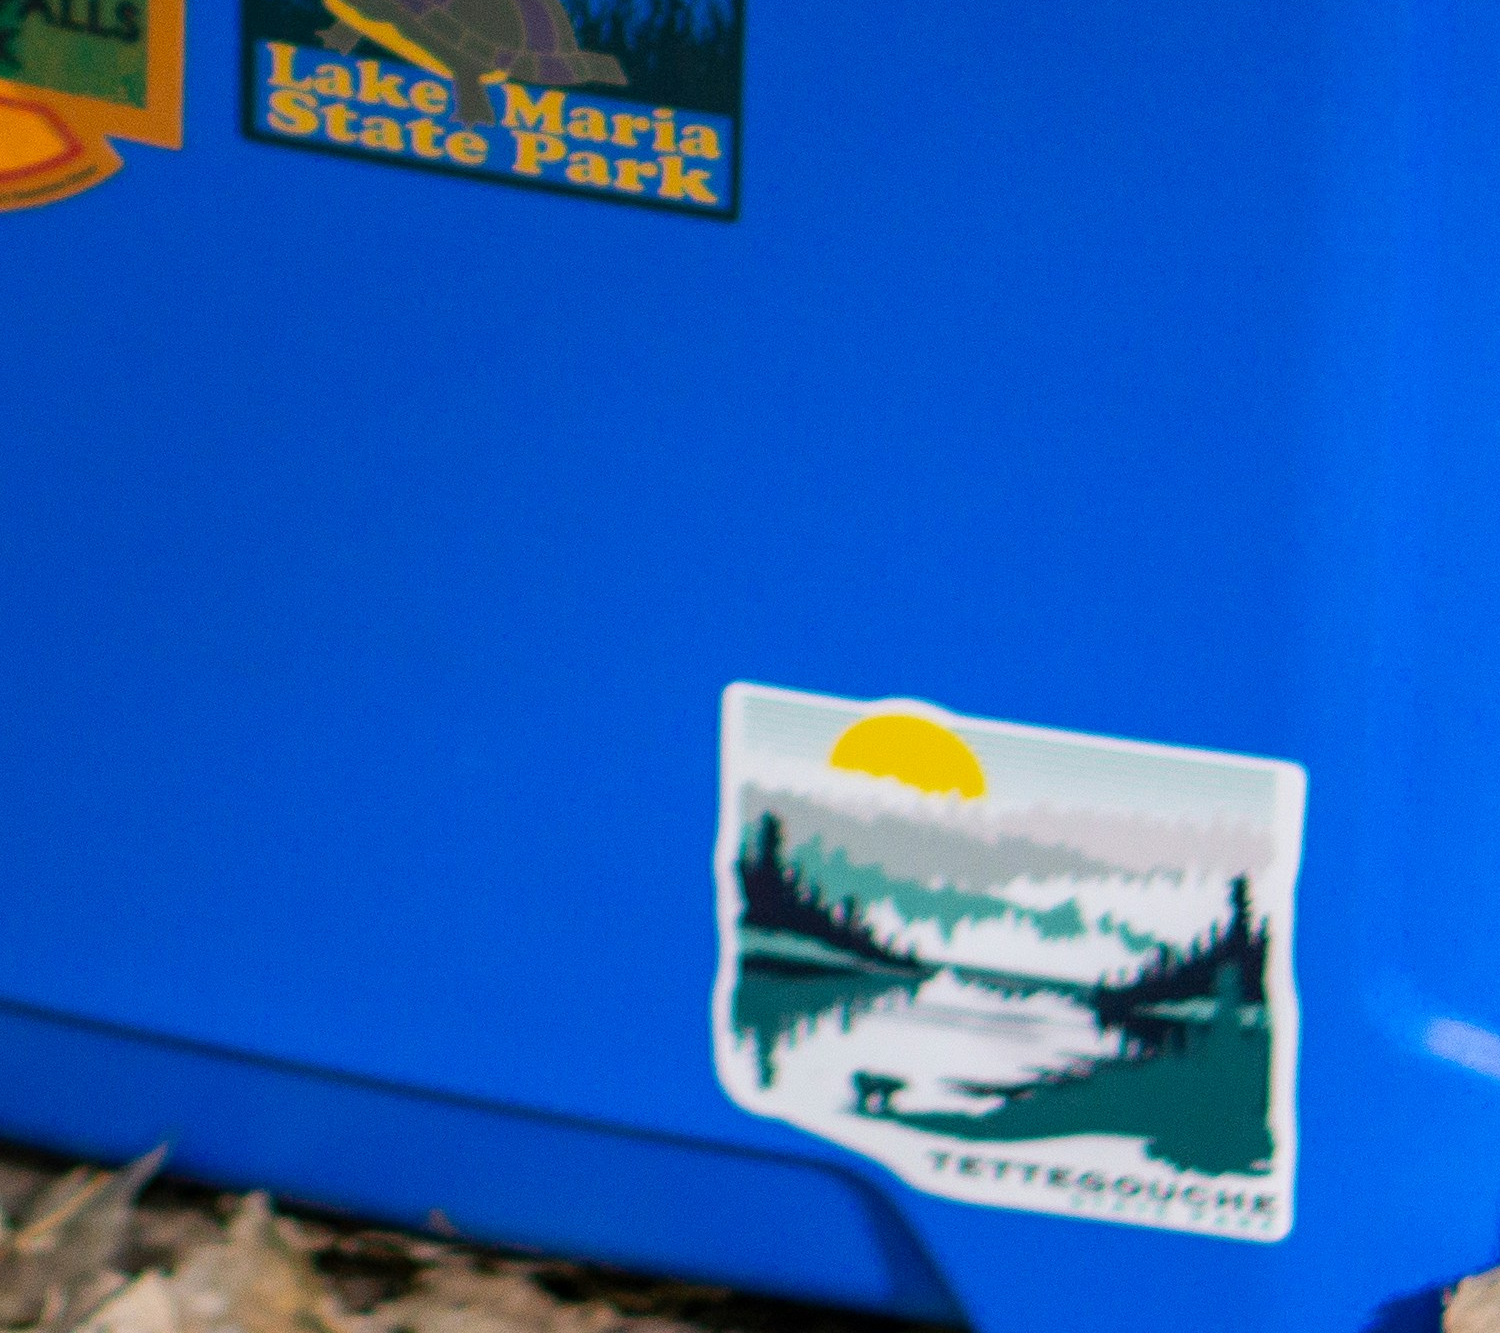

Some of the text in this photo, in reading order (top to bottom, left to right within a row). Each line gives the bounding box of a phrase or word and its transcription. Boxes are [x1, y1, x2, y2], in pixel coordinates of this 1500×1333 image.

[266, 40, 722, 161] Lake Maria
[266, 88, 719, 205] State Park
[926, 1147, 1276, 1217] TETTEGOUCHE
